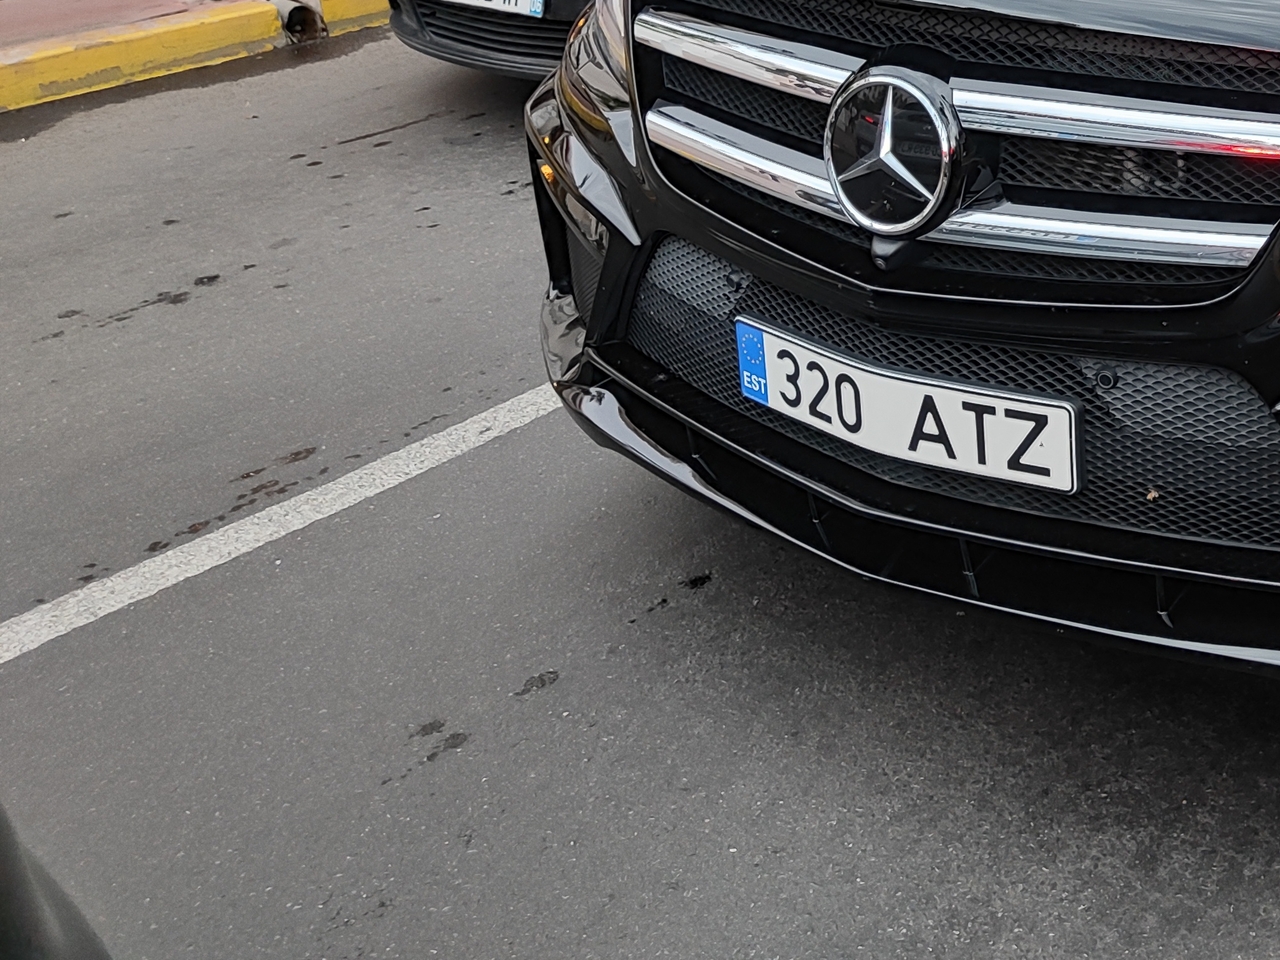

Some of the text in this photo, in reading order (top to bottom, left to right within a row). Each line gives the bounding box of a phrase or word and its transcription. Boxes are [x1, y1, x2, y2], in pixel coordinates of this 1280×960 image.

[743, 370, 766, 395] EST
[776, 349, 1051, 478] 320 ATZ
